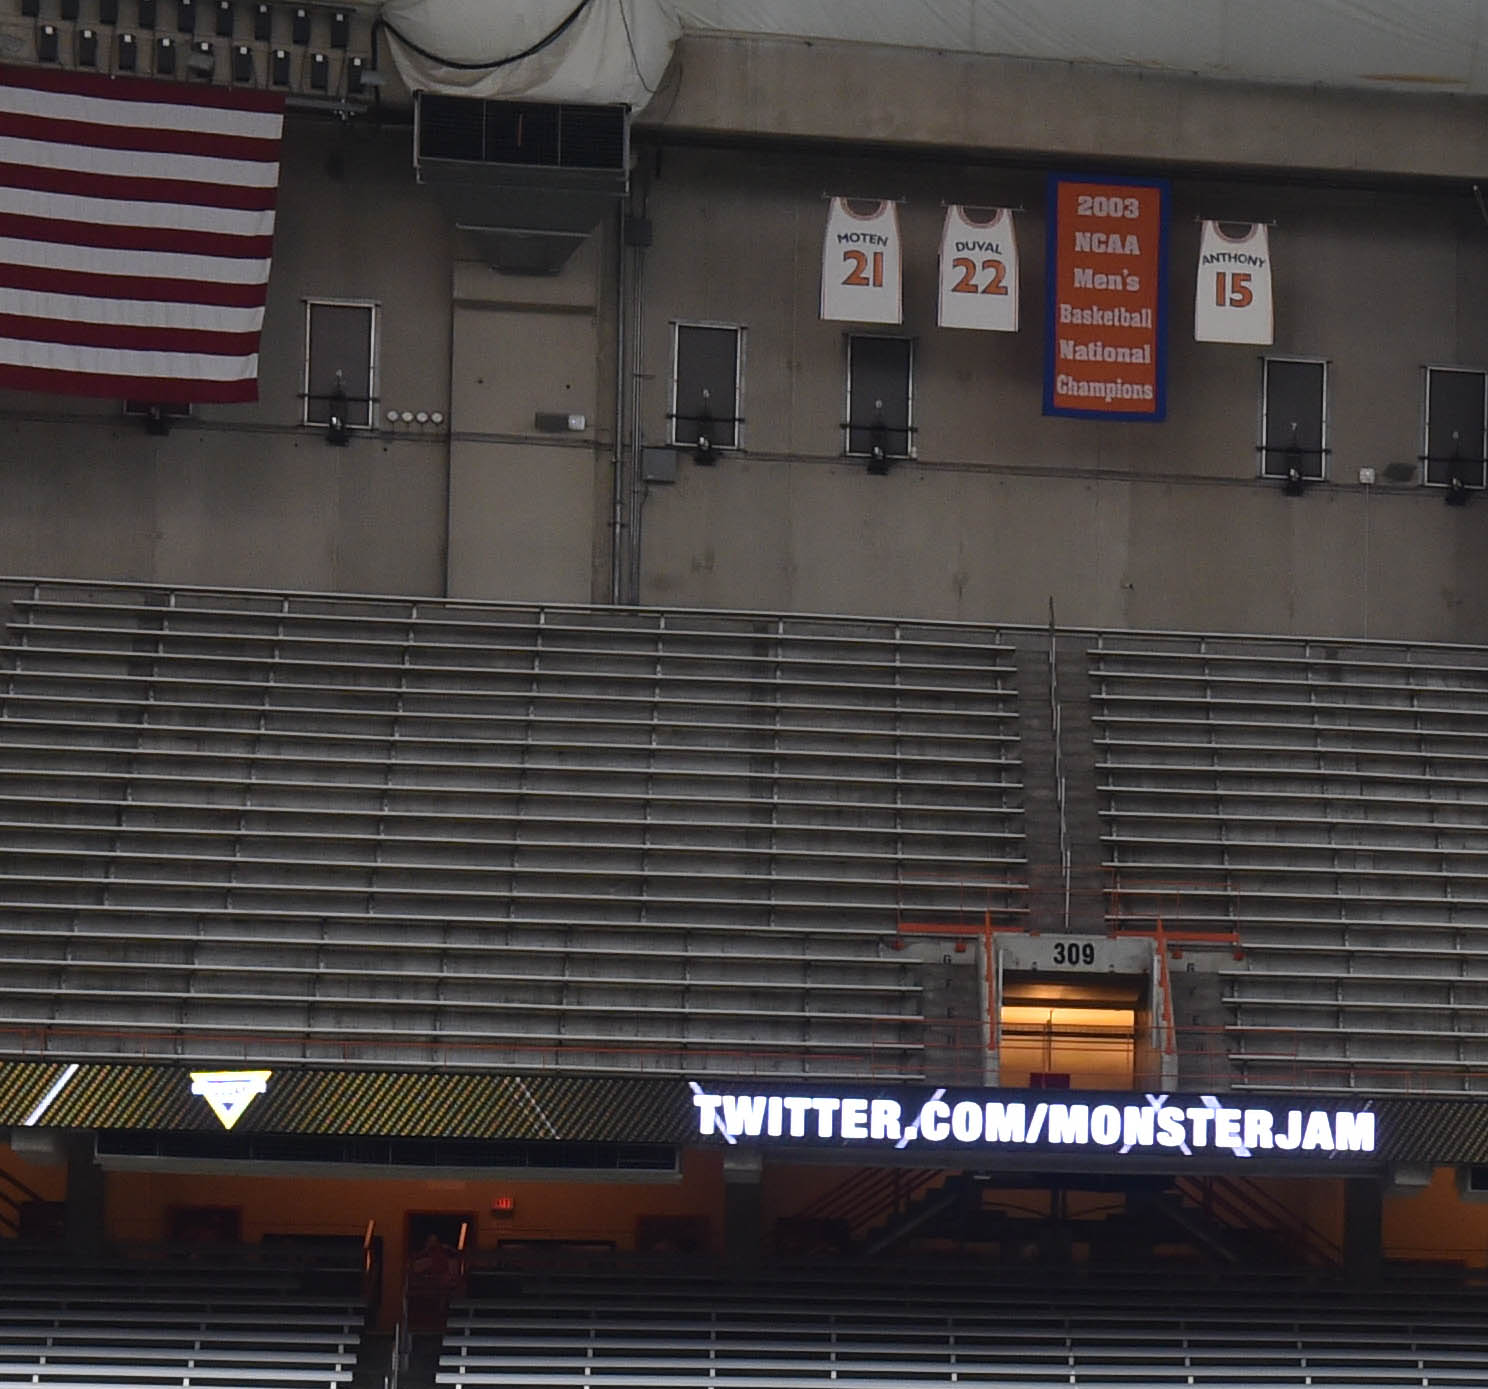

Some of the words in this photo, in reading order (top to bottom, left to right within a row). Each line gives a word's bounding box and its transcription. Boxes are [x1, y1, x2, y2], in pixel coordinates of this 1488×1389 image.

[1077, 196, 1140, 218] 2003
[837, 231, 889, 248] MOTEN
[955, 240, 1003, 255] DUVAL
[1074, 233, 1141, 256] NCAA
[842, 250, 883, 287] 21
[1201, 252, 1266, 270] ANTHONY
[951, 258, 1009, 296] 22
[1073, 268, 1141, 292] Men's
[1215, 272, 1254, 308] 15
[1060, 304, 1152, 329] Basketball
[1060, 340, 1152, 365] National
[1056, 375, 1154, 402] Champions
[1053, 942, 1095, 965] 309
[693, 1094, 1376, 1152] TWITTER.COM/MONSTERJAM
